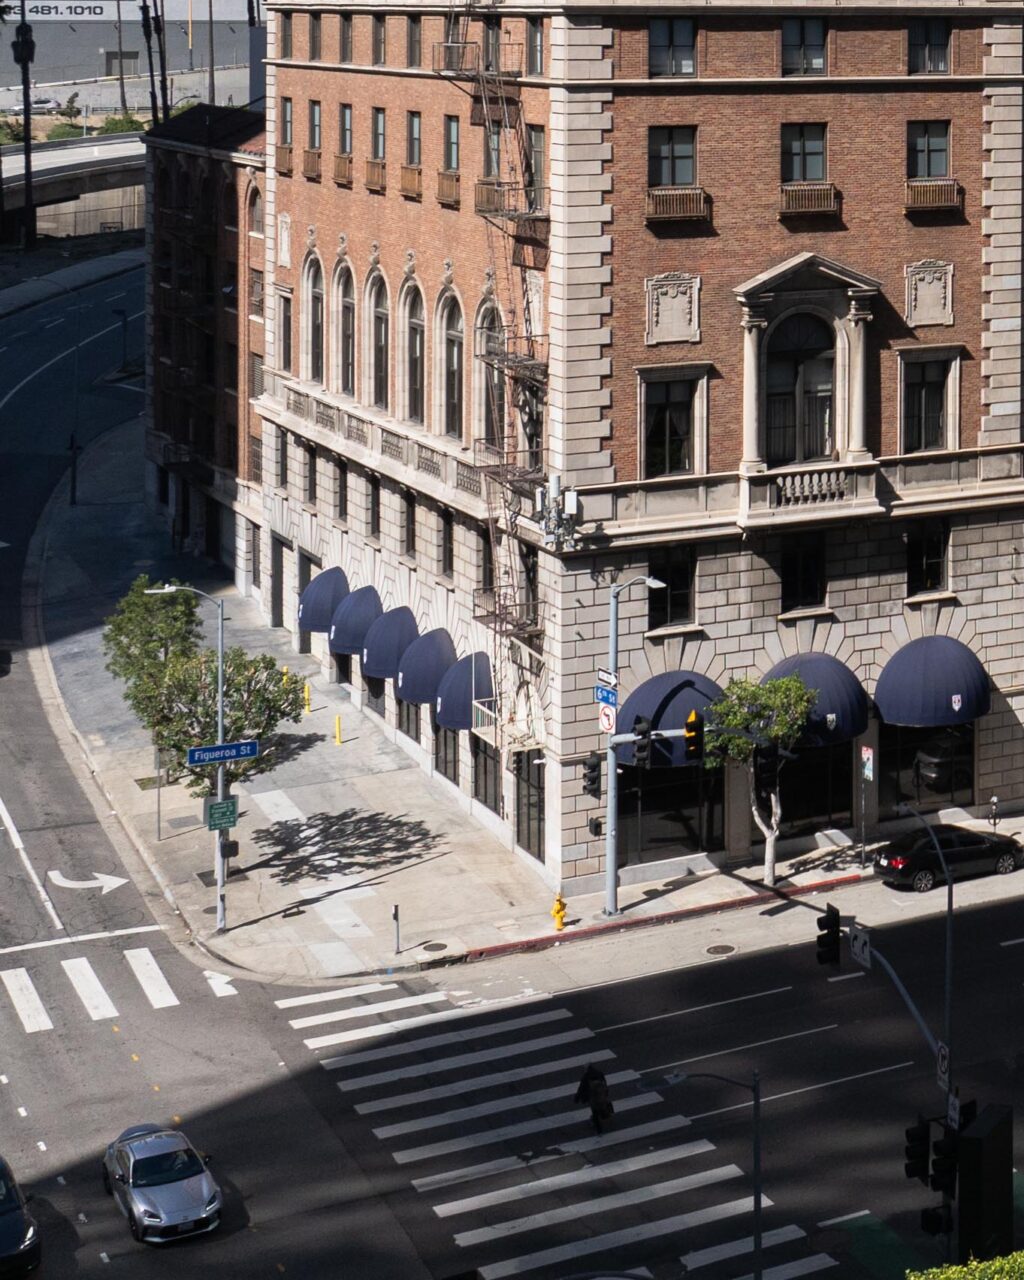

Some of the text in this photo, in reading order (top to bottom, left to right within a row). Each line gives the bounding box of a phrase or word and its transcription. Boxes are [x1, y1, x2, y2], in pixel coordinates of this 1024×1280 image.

[29, 5, 104, 15] 481.1010
[194, 745, 251, 761] Figueroa St
